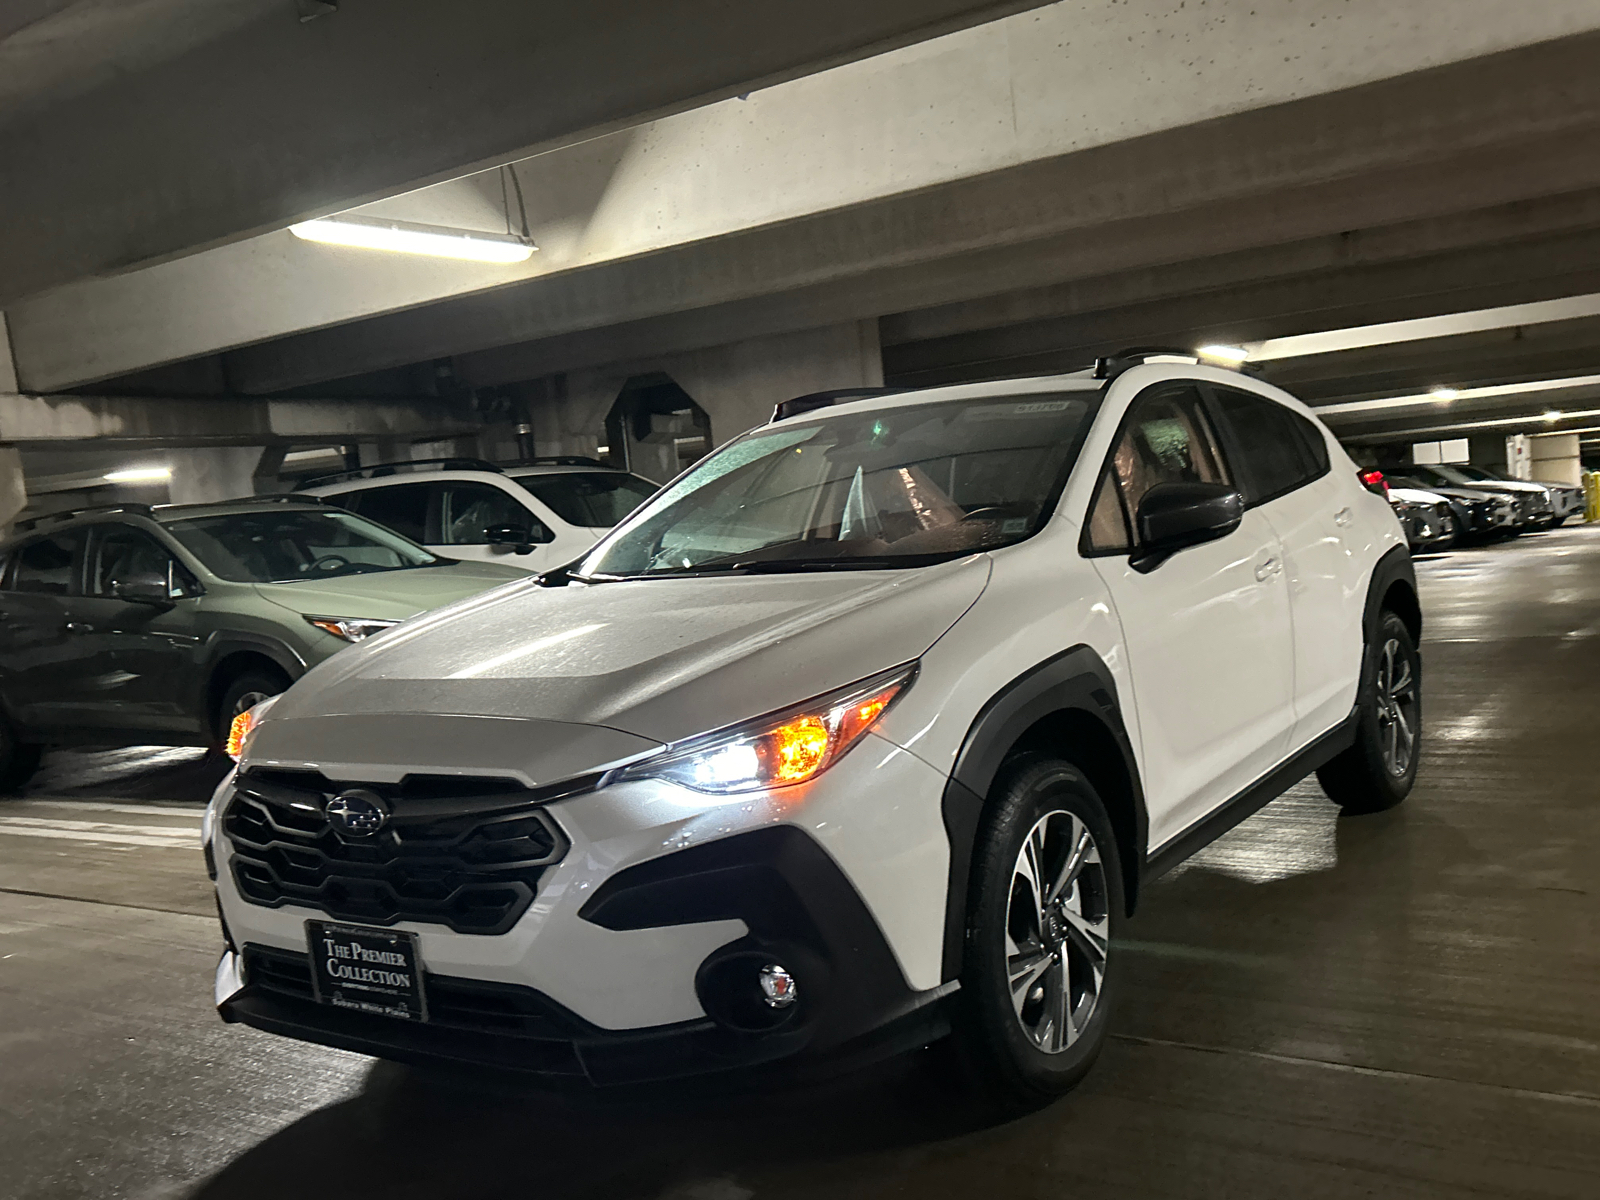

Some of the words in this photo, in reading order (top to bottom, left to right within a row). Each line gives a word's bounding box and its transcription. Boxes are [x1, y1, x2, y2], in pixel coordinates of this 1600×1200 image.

[323, 938, 351, 959] THE
[350, 942, 407, 966] PREMIER
[326, 958, 411, 988] COLLECTION
